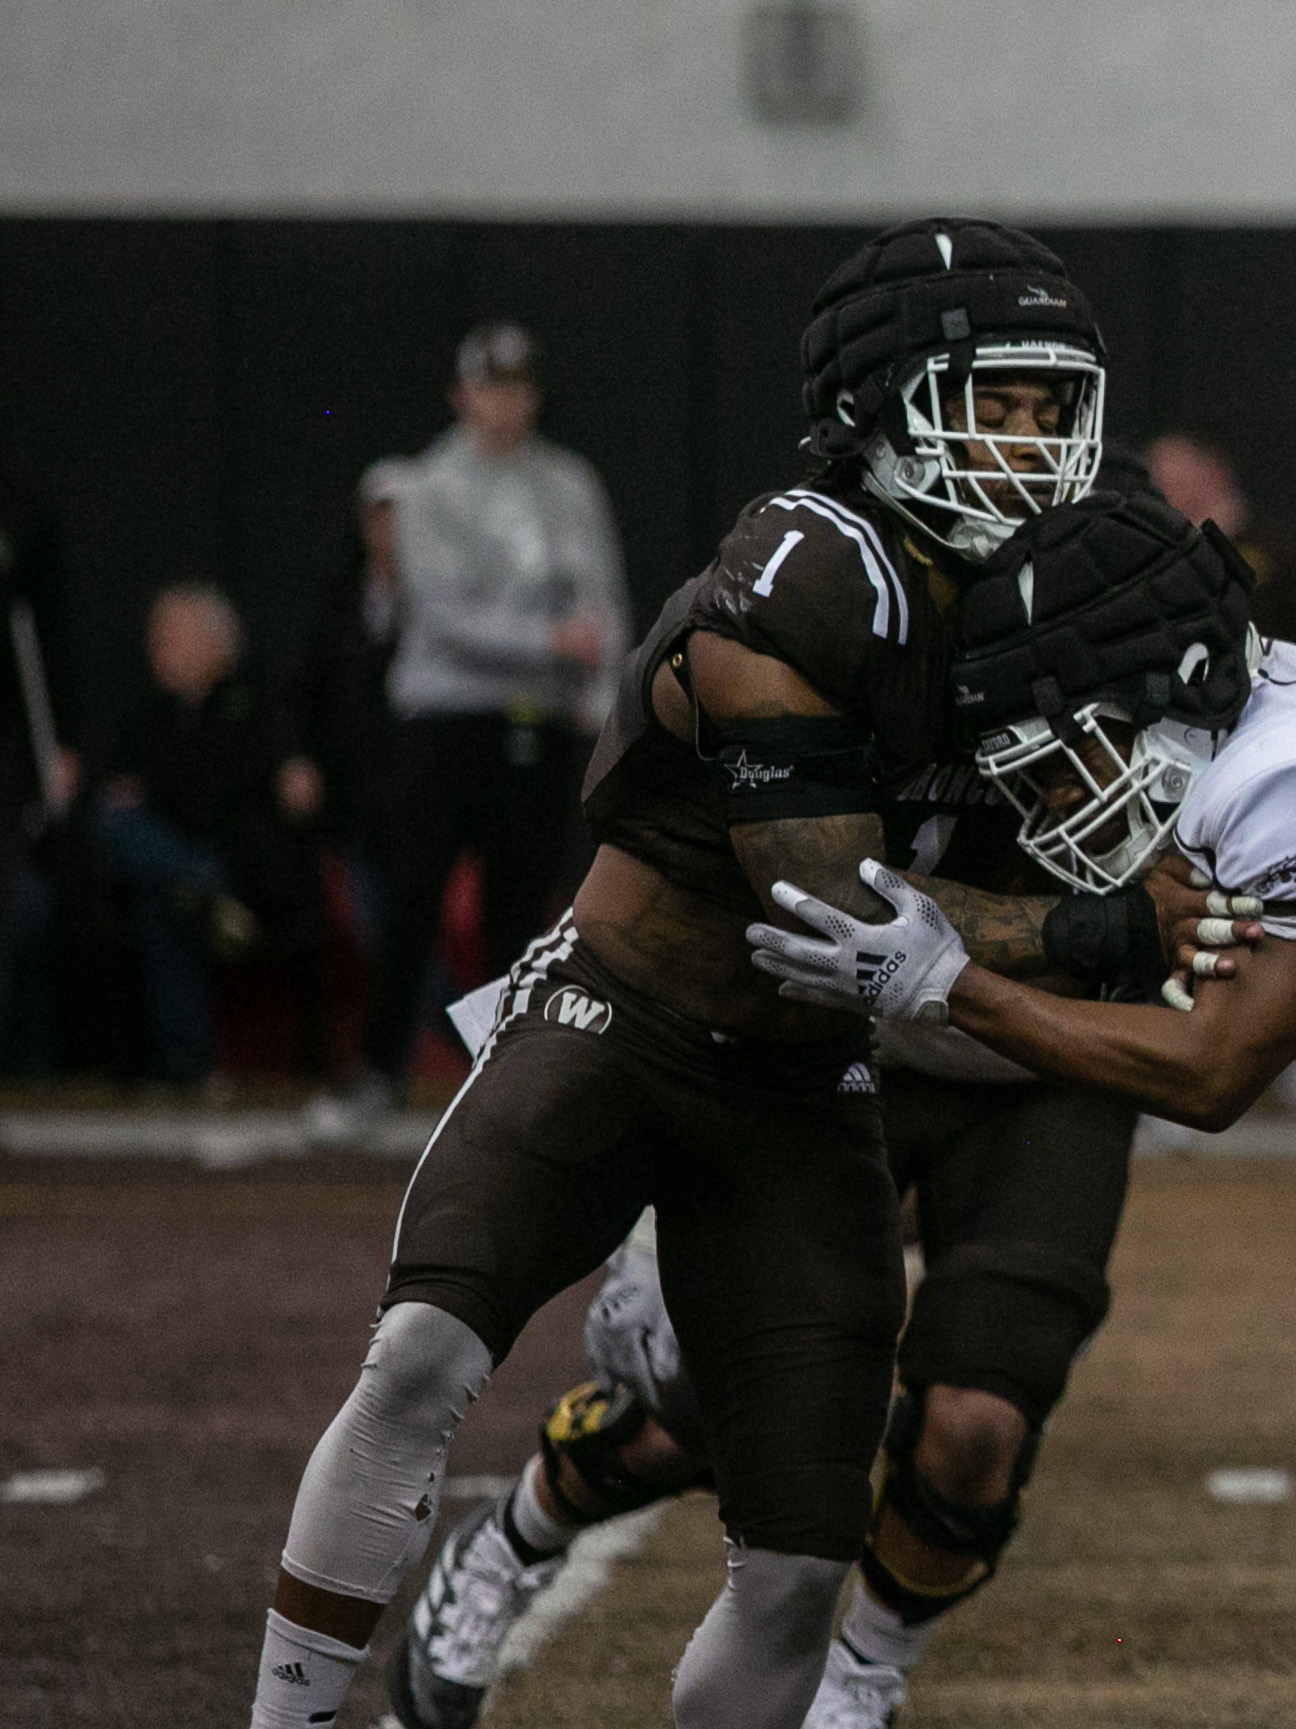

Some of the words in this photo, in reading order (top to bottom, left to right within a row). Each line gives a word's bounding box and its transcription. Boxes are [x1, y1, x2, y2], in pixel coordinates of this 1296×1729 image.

[1018, 295, 1067, 309] GUARDIAN
[752, 529, 805, 598] 1
[739, 765, 790, 783] Douglas
[864, 951, 907, 1007] adidas
[557, 991, 606, 1030] W
